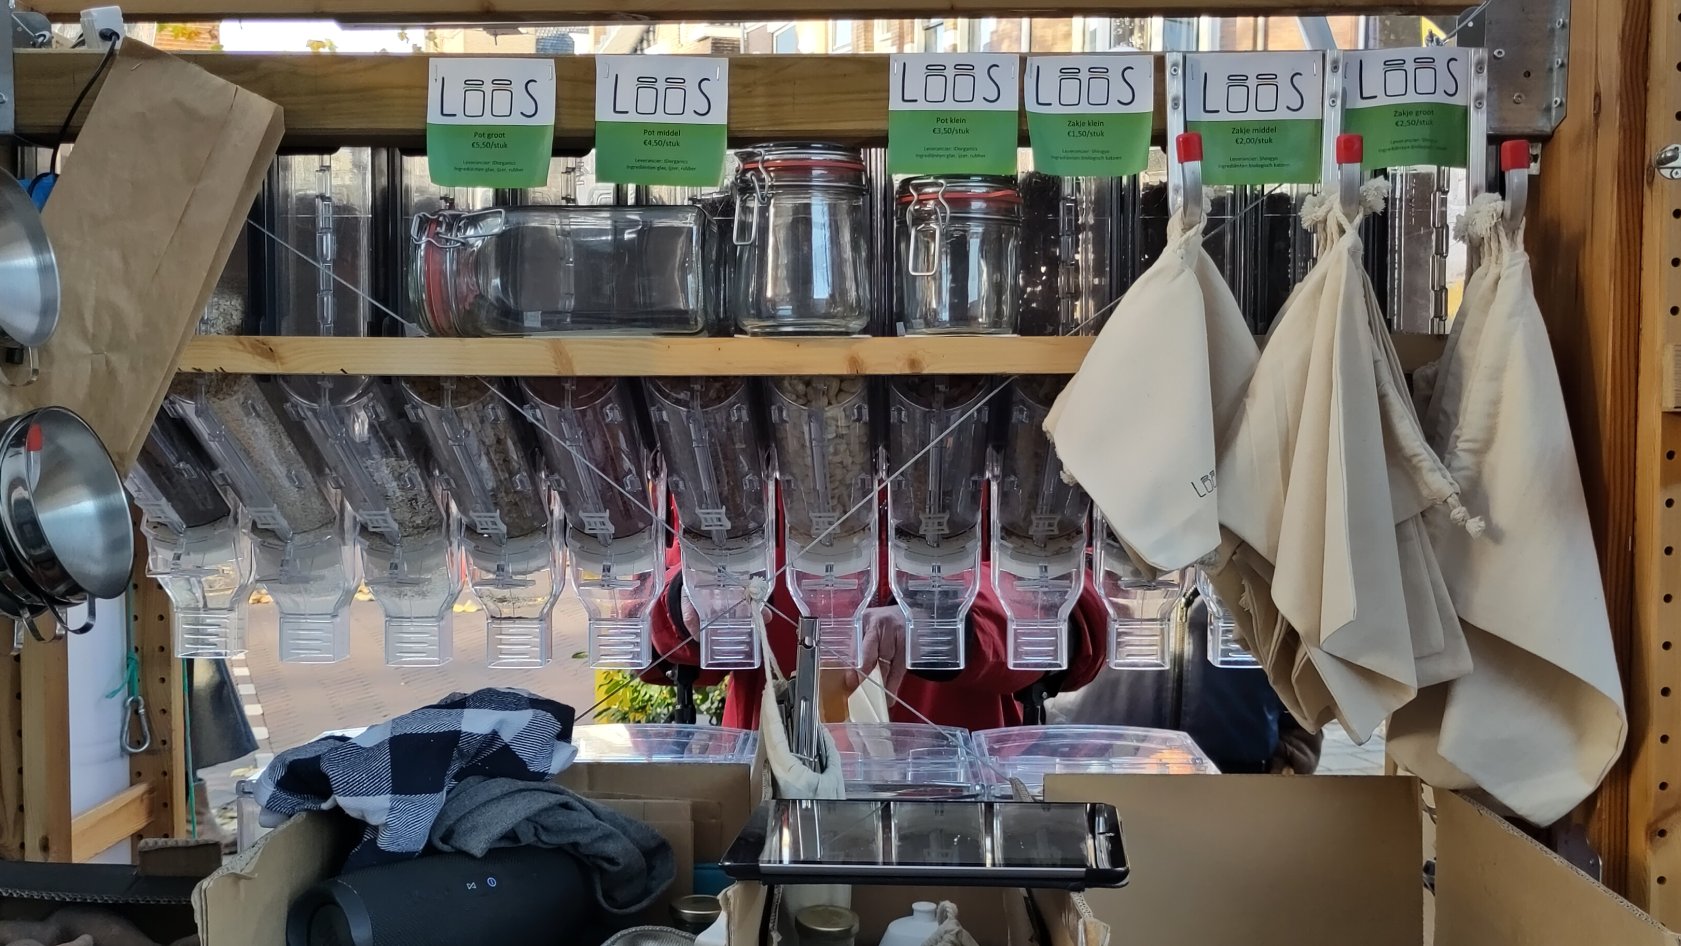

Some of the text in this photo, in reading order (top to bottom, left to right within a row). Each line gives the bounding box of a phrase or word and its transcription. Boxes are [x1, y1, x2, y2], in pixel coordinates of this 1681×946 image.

[1393, 109, 1434, 118] Zakje groot
[1067, 120, 1086, 128] Zakje
[656, 129, 681, 137] middel
[932, 127, 970, 136] €3,50/stuk
[1067, 130, 1105, 138] €1,50/stuk
[1231, 126, 1277, 135] Zakje middel
[473, 131, 505, 140] Pot groot
[471, 141, 508, 149] €5,50/stuk
[643, 139, 681, 148] €4,50/stuk
[1235, 137, 1273, 145] €2,00/stuk
